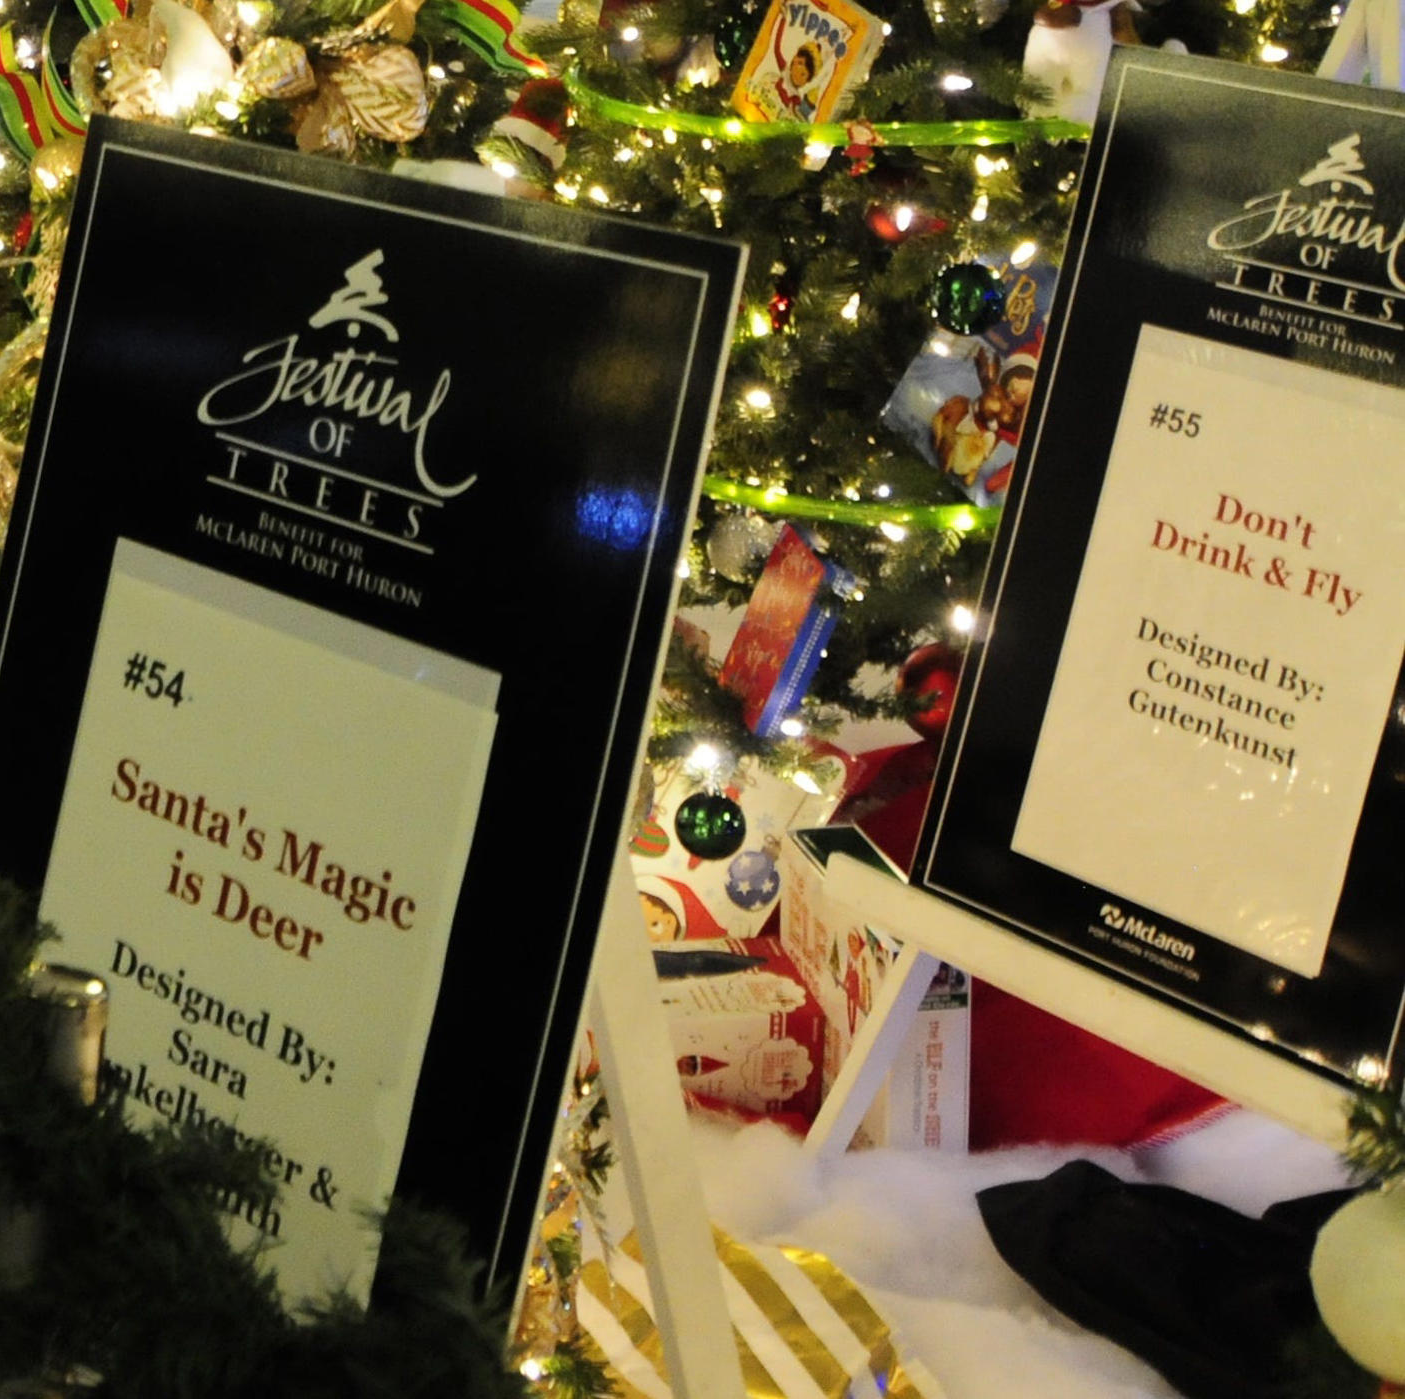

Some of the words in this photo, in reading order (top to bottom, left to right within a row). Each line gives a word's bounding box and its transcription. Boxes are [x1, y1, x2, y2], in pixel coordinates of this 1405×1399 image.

[1300, 243, 1339, 270] OF
[1232, 263, 1395, 322] TREES
[1259, 305, 1315, 329] BENEFIT
[1318, 319, 1347, 337] FOR
[1286, 326, 1329, 348] PORT
[1332, 337, 1396, 364] HURON
[197, 334, 478, 498] Festival
[309, 417, 355, 458] OF
[1150, 403, 1203, 439] #55
[227, 446, 423, 539] TREES
[1214, 492, 1317, 551] Don't
[259, 512, 325, 548] BENEFIT
[330, 537, 364, 562] FOR
[291, 544, 340, 579] PORT
[347, 564, 423, 608] HURON
[1150, 519, 1257, 579] Drink
[1263, 555, 1294, 593] &
[1301, 567, 1364, 617] Fly
[123, 652, 186, 708] #54
[1137, 616, 1270, 684] Designed
[1277, 663, 1325, 703] By:
[1145, 658, 1297, 731] Constance
[1128, 688, 1298, 771] Gutenkunst
[111, 758, 266, 862] Santa's
[274, 829, 417, 931] Magic
[166, 850, 204, 905] is
[212, 872, 324, 961] Deer
[1123, 915, 1195, 962] McLaren
[110, 940, 271, 1050] Designed
[276, 1025, 336, 1086] By:
[167, 1028, 248, 1100] Sara
[309, 1166, 338, 1212] &
